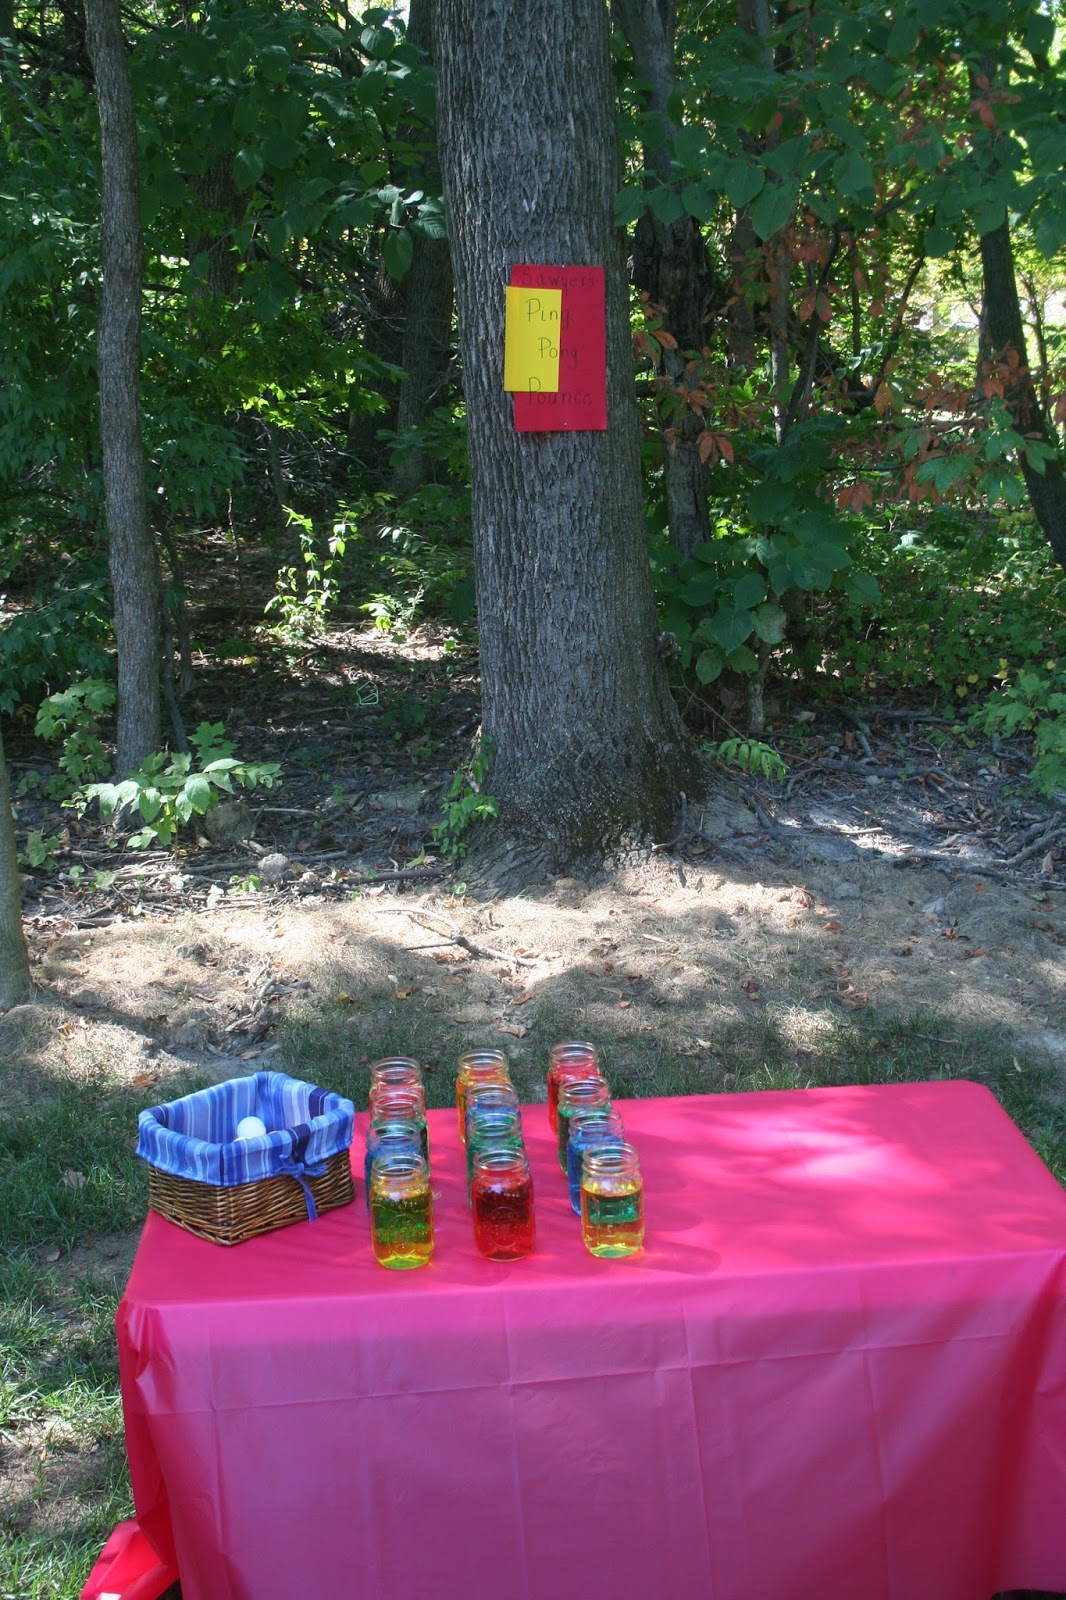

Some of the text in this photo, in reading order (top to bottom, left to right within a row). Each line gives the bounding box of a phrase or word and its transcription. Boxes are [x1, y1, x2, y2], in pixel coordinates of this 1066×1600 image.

[525, 298, 570, 331] Ping
[538, 337, 577, 370] Pong
[528, 376, 592, 406] Pounce
